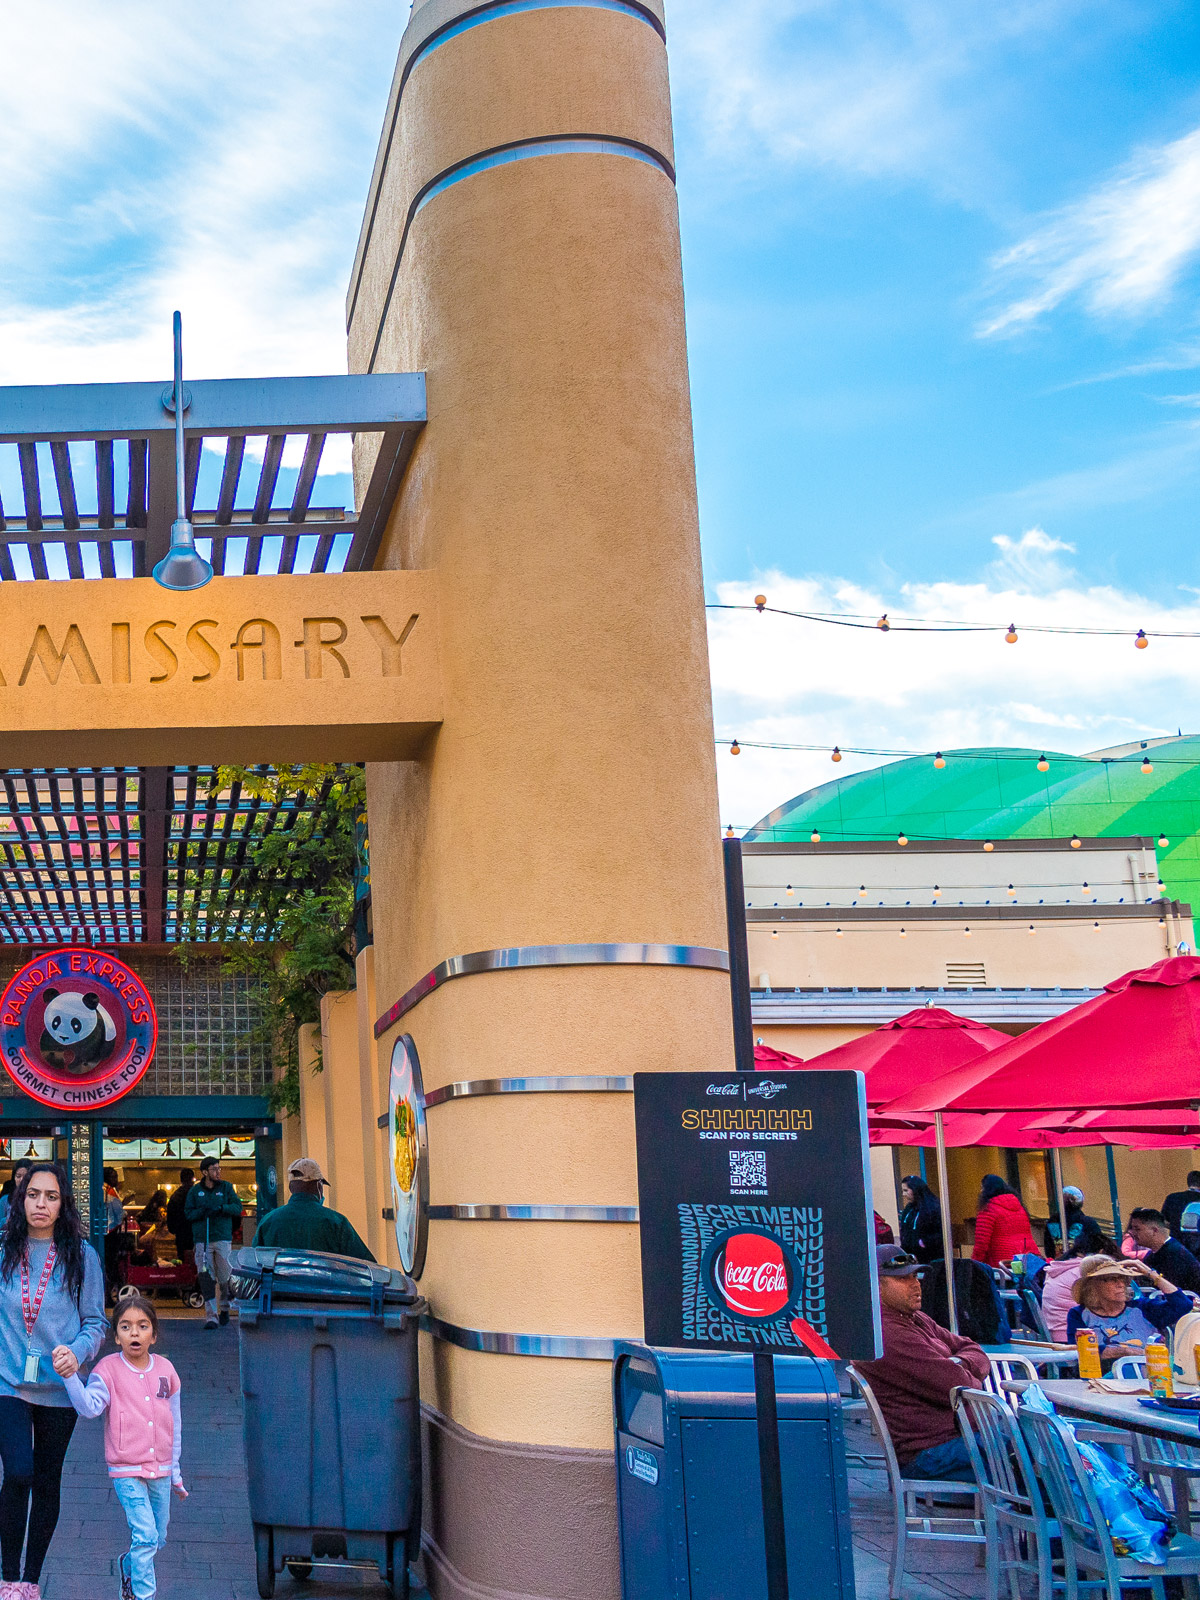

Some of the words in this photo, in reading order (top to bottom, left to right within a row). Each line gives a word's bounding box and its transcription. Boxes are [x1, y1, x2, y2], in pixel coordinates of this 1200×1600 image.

[3, 959, 63, 1027] PANDA
[70, 954, 150, 1024] EXPRESS
[7, 1046, 59, 1099] GOURMET
[63, 1078, 121, 1103] CHINESE
[120, 1045, 147, 1082] FOOD
[681, 1109, 813, 1130] SHHHHH
[699, 1131, 728, 1140] SCAN
[729, 1132, 751, 1140] FOR
[752, 1132, 798, 1141] SECRETS
[677, 1203, 823, 1224] SECRETMENU
[725, 1262, 788, 1293] Coca-Cola
[156, 1376, 170, 1399] A
